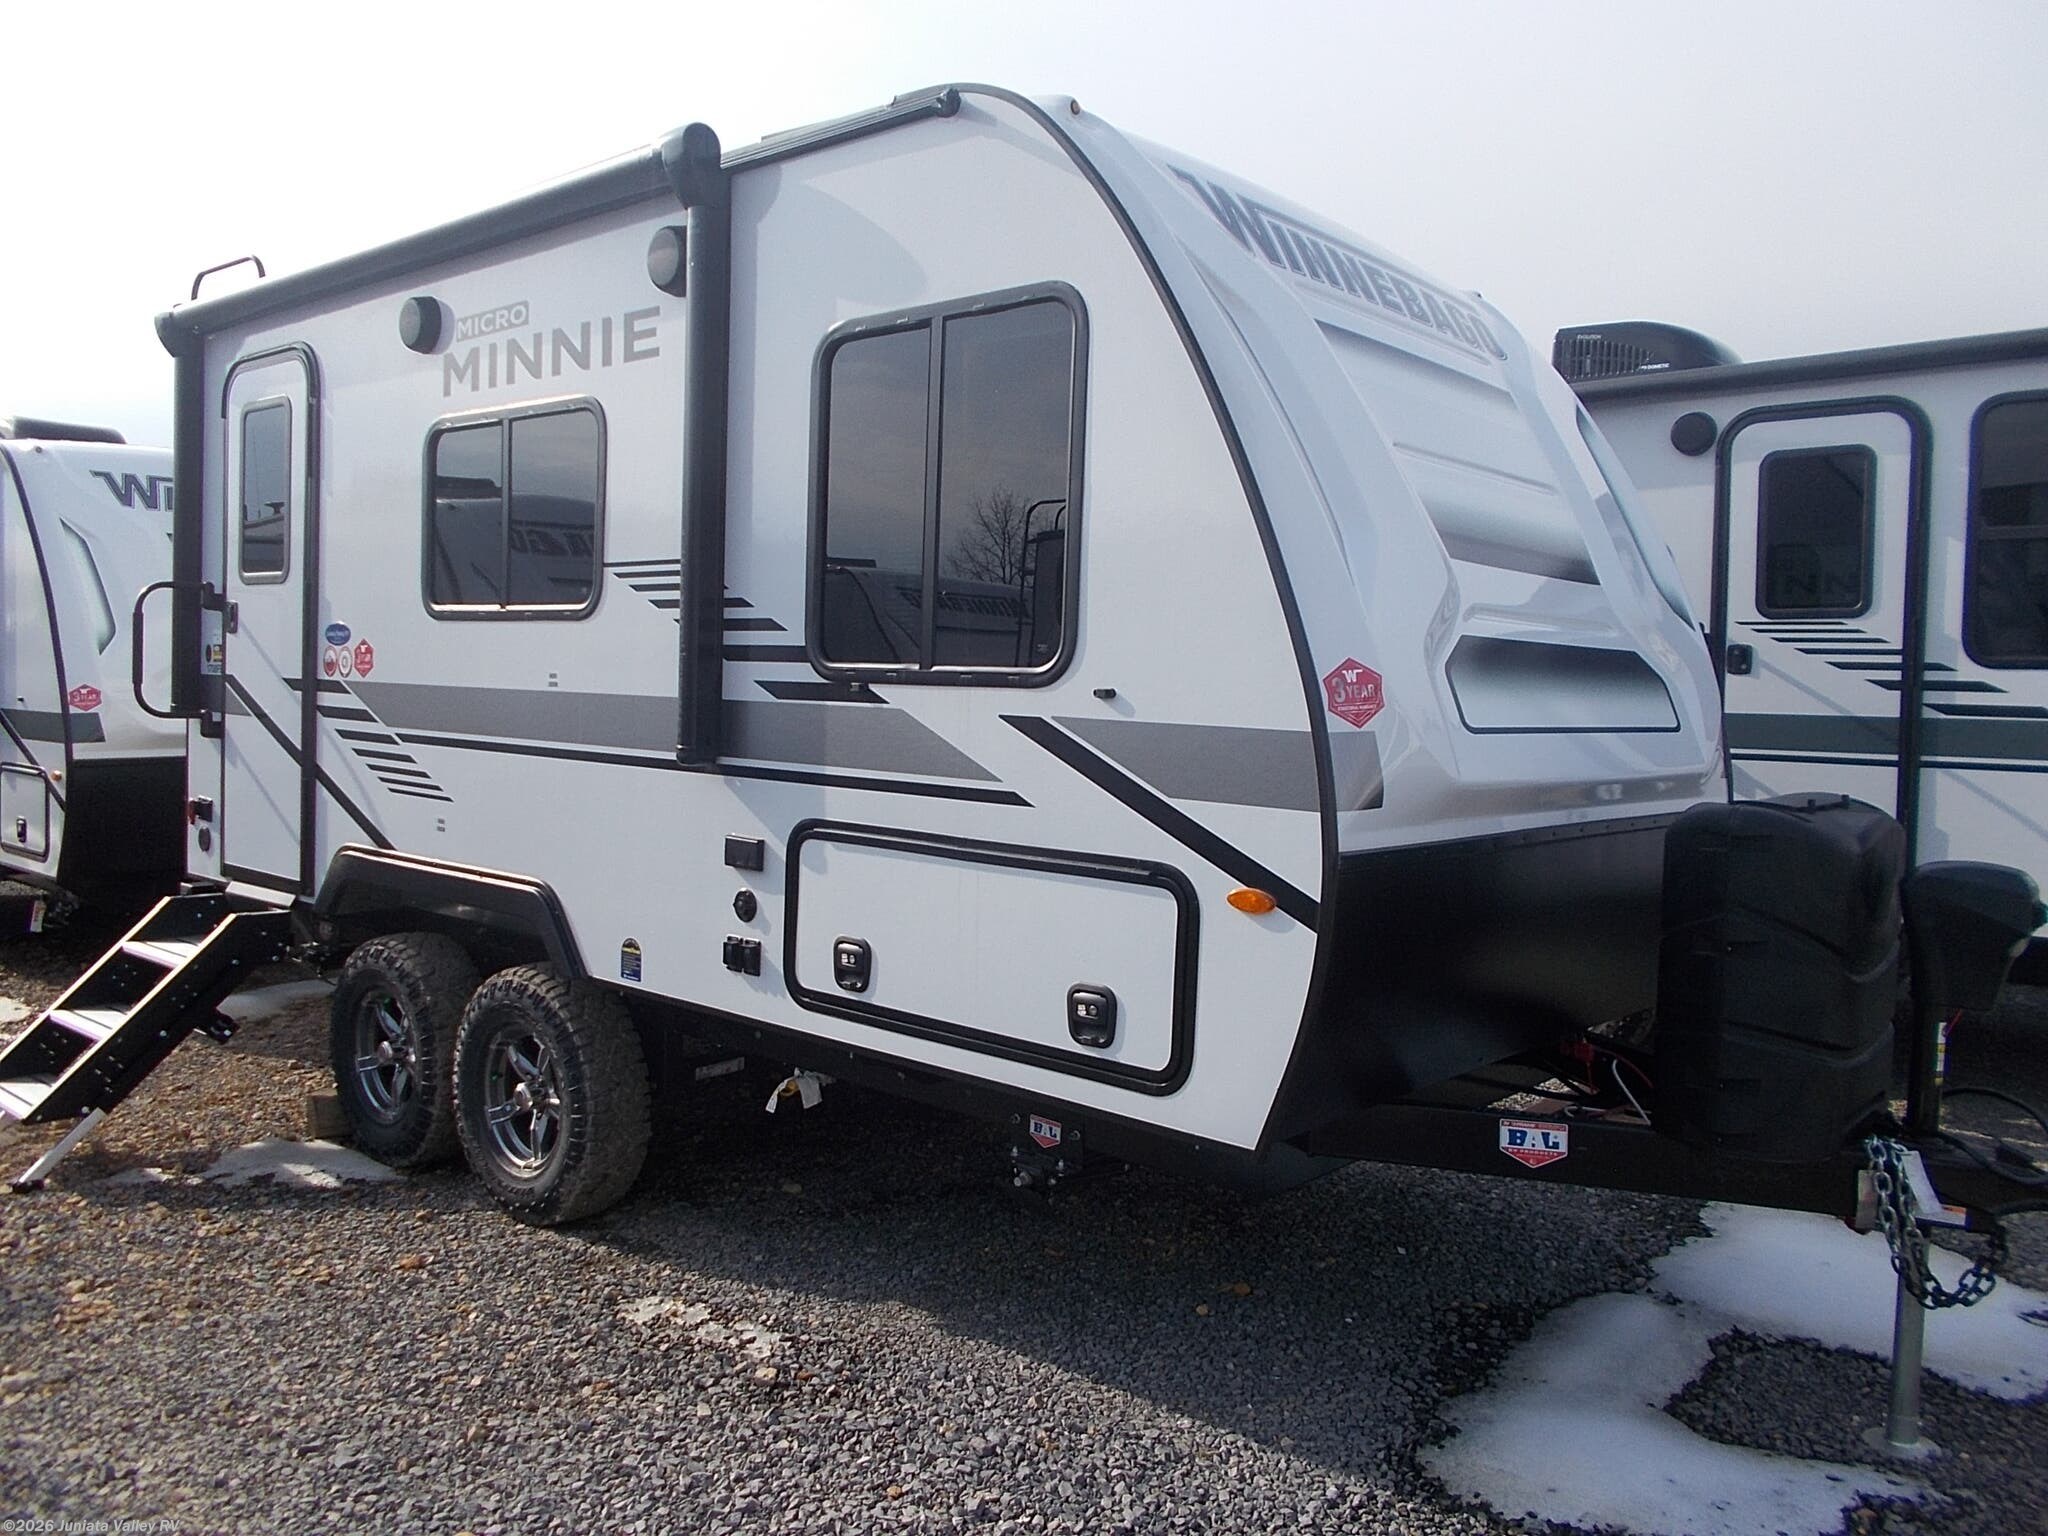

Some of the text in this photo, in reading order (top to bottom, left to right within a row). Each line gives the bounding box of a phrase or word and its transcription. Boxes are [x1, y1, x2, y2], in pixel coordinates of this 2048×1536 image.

[1165, 163, 1508, 361] WINNEBAGO
[457, 305, 528, 341] MICRO
[443, 305, 661, 397] MINNIE
[1332, 676, 1376, 703] 3 YEAR
[1507, 1128, 1560, 1150] BAL
